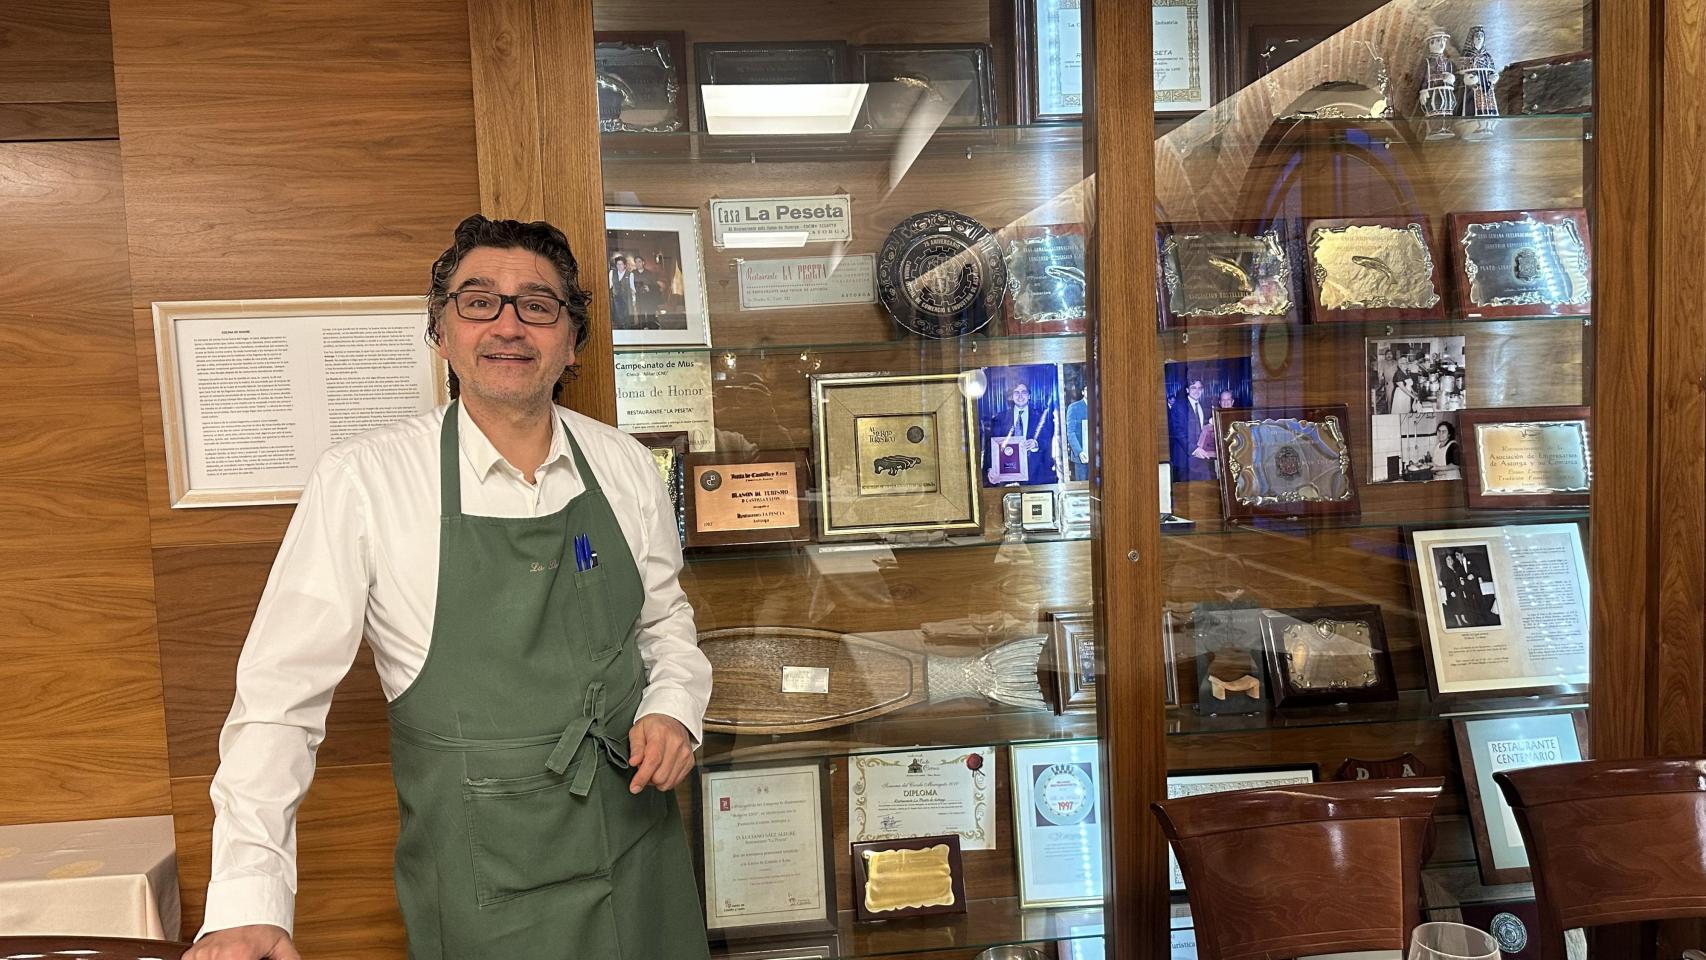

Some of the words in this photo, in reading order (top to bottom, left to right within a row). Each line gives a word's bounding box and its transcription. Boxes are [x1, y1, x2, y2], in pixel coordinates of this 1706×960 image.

[718, 207, 741, 223] Casa
[745, 206, 770, 221] La
[776, 203, 844, 220] Peseta
[782, 264, 792, 280] LA
[797, 263, 828, 281] PESETA
[615, 361, 665, 371] Campeonato
[666, 360, 676, 368] de
[677, 360, 695, 368] Mus
[616, 387, 645, 400] loma
[650, 386, 664, 398] de
[668, 385, 704, 398] Honor
[626, 408, 663, 416] RESTAURANTE
[1491, 739, 1557, 753] RESTAURANTE
[903, 789, 938, 797] DIPLOMA
[1057, 801, 1074, 811] 1997
